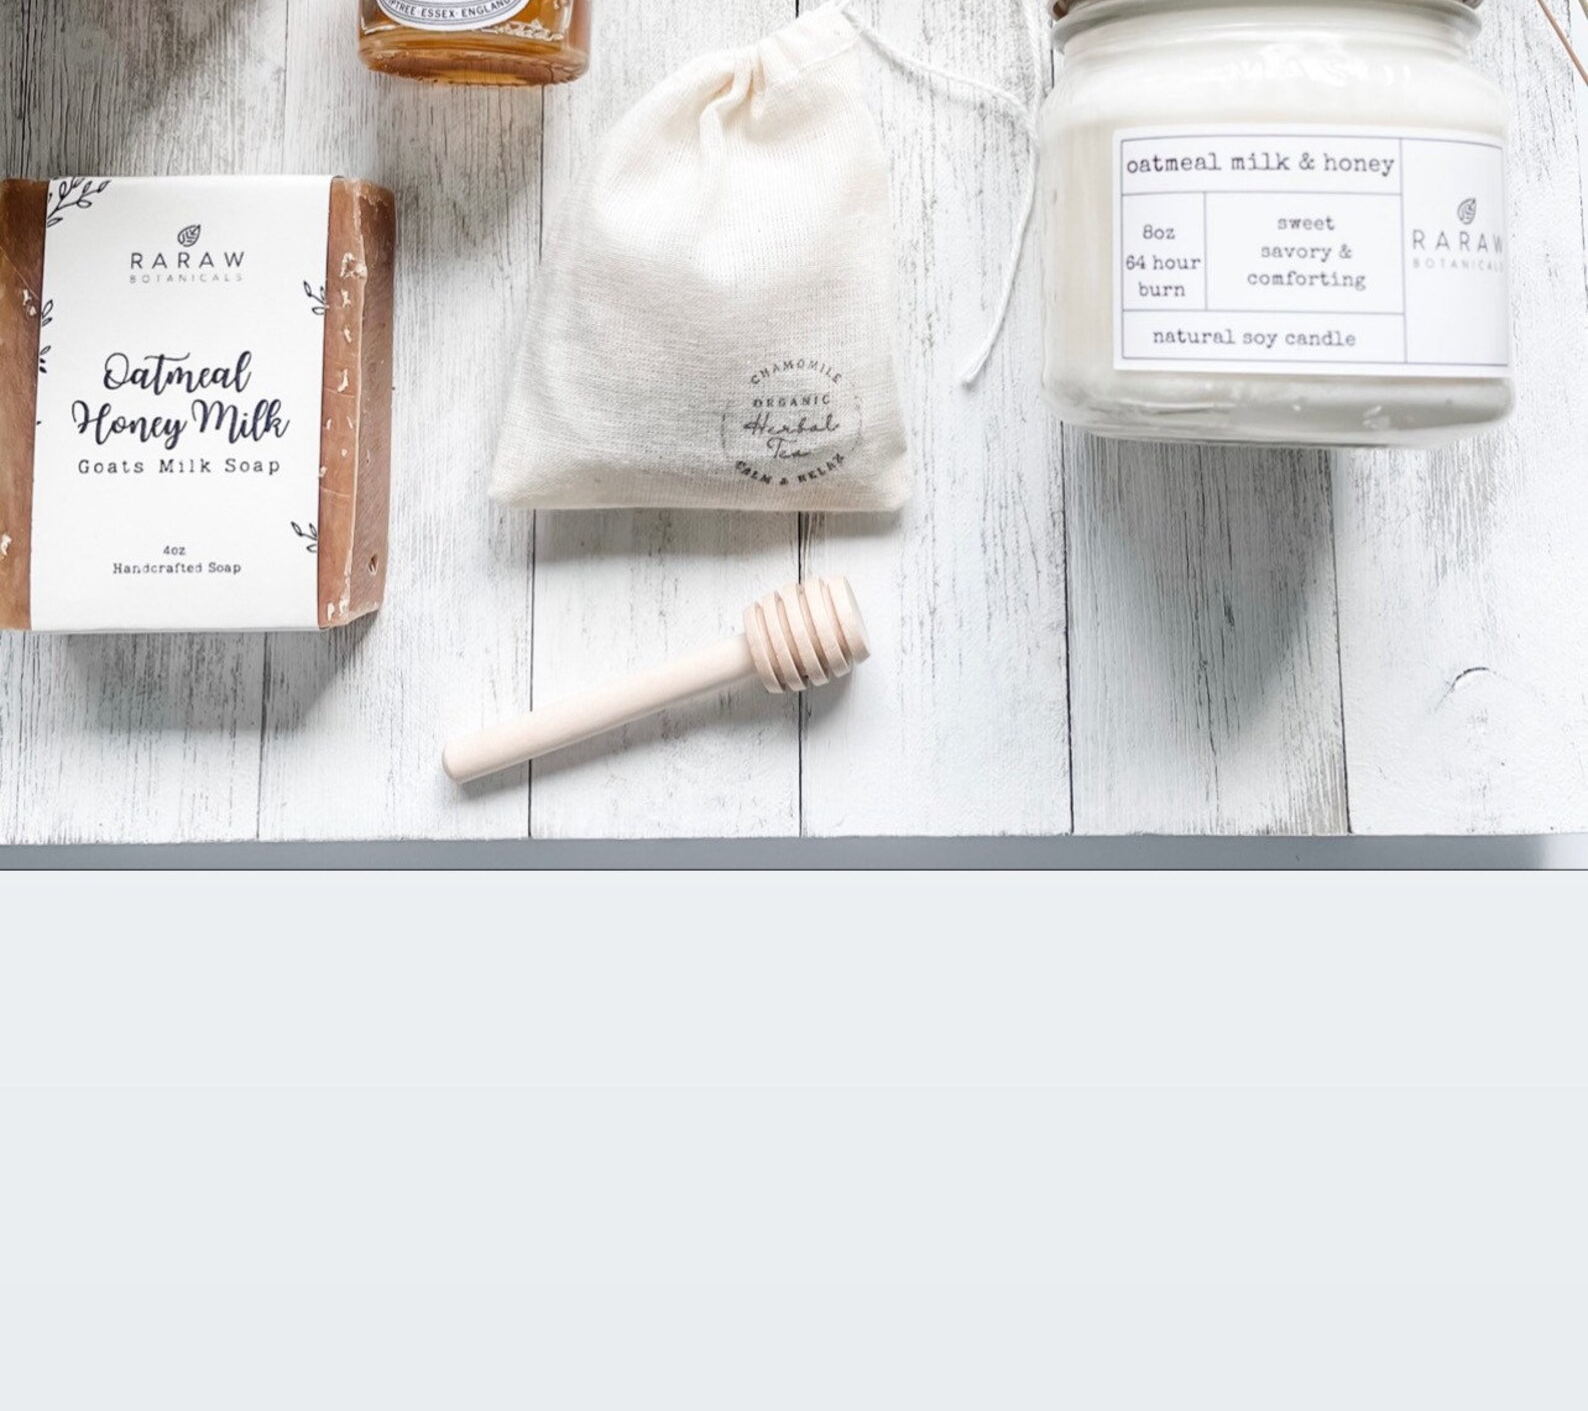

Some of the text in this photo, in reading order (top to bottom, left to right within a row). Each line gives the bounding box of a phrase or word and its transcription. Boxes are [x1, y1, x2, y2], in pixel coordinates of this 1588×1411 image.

[421, 7, 455, 19] ESSEX
[1126, 152, 1396, 177] oatmeal milk & honey
[1142, 224, 1176, 241] 8oz
[1277, 215, 1336, 232] sweet
[1412, 229, 1503, 254] RARAW
[130, 251, 245, 270] RARAW
[1260, 243, 1353, 263] savory &
[1125, 254, 1202, 272] 64 hour
[129, 273, 244, 285] BOTANICALS
[1247, 270, 1367, 291] comforting
[1137, 281, 1186, 298] burn
[1152, 328, 1357, 349] natural soy candle
[102, 350, 253, 397] Oatmeal
[750, 358, 843, 385] CHAMOMILE
[753, 394, 831, 408] ORGANIC
[71, 398, 291, 451] Honey Milk
[743, 412, 840, 436] Herbal
[766, 437, 812, 460] Tea
[78, 457, 281, 476] Goats Milk Soap
[735, 460, 773, 485] CALM
[797, 452, 845, 484] RELAX
[163, 545, 186, 556] 4oz
[113, 561, 242, 575] Handcrafted Soap
